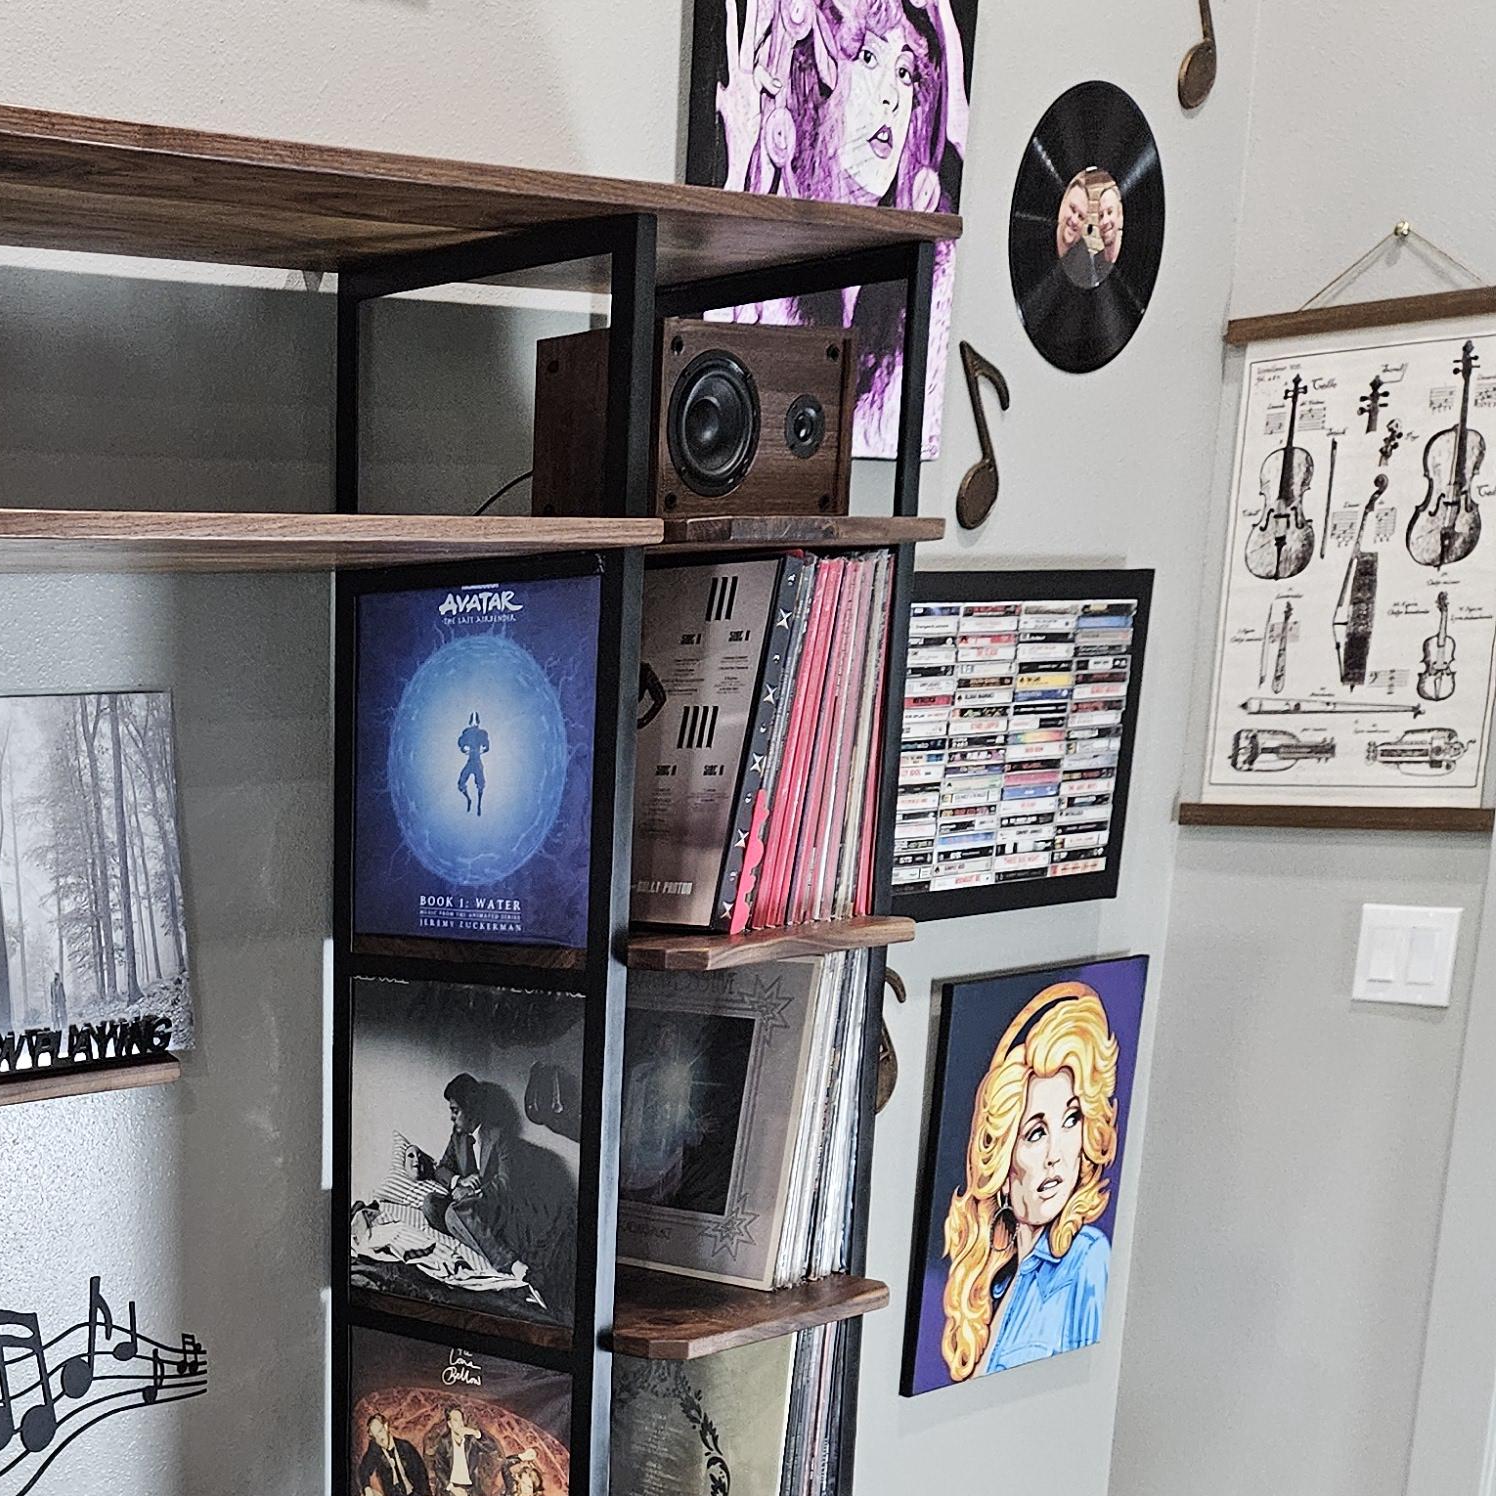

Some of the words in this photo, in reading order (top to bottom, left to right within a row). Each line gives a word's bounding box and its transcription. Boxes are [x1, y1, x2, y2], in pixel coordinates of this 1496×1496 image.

[439, 591, 523, 615] AVATAR
[420, 896, 453, 908] BOOK
[476, 898, 521, 911] WATER
[419, 918, 455, 928] JEREMY
[459, 920, 522, 932] ZUCKERMAN
[24, 1013, 174, 1070] PLAYING
